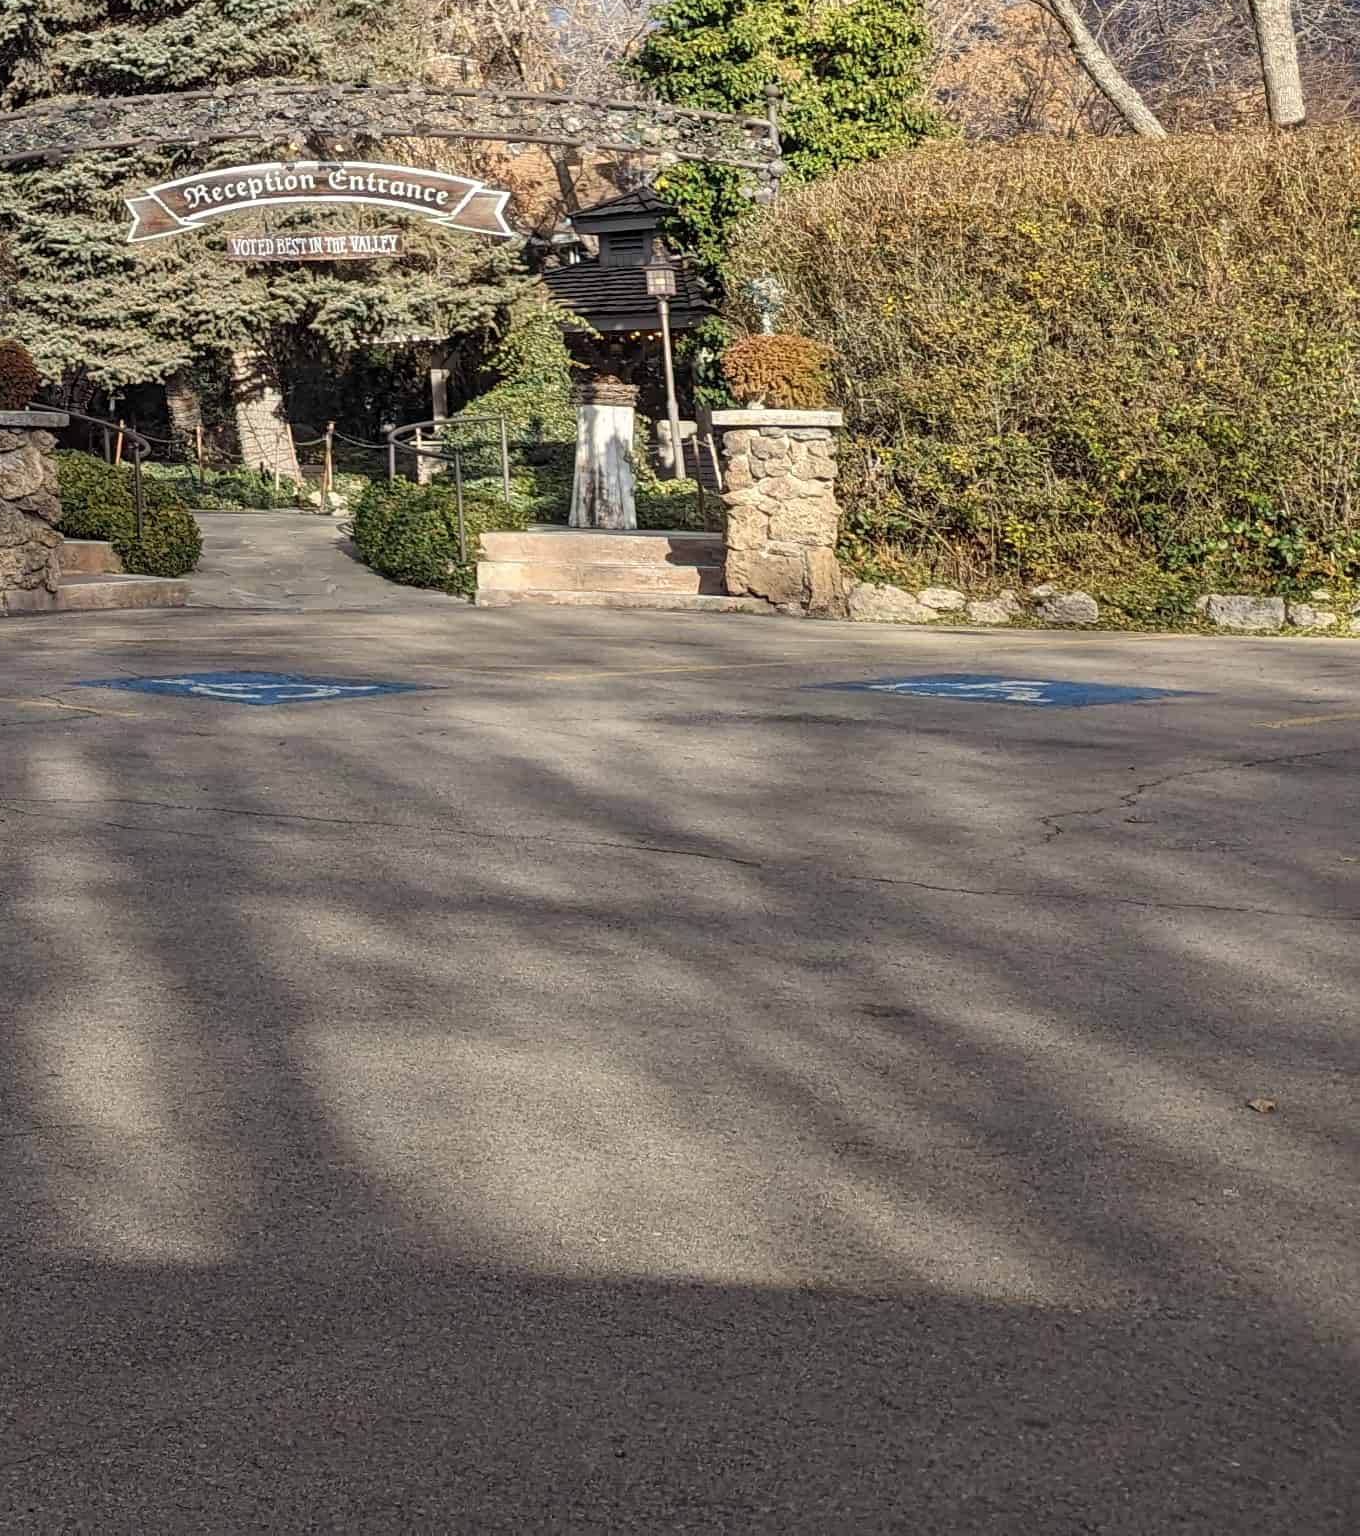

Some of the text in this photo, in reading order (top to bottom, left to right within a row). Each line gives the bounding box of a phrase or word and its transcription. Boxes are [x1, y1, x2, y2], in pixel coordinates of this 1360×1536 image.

[183, 168, 449, 209] Reception Entrance
[231, 234, 399, 256] VOTED BEST IN THE VALLEY
